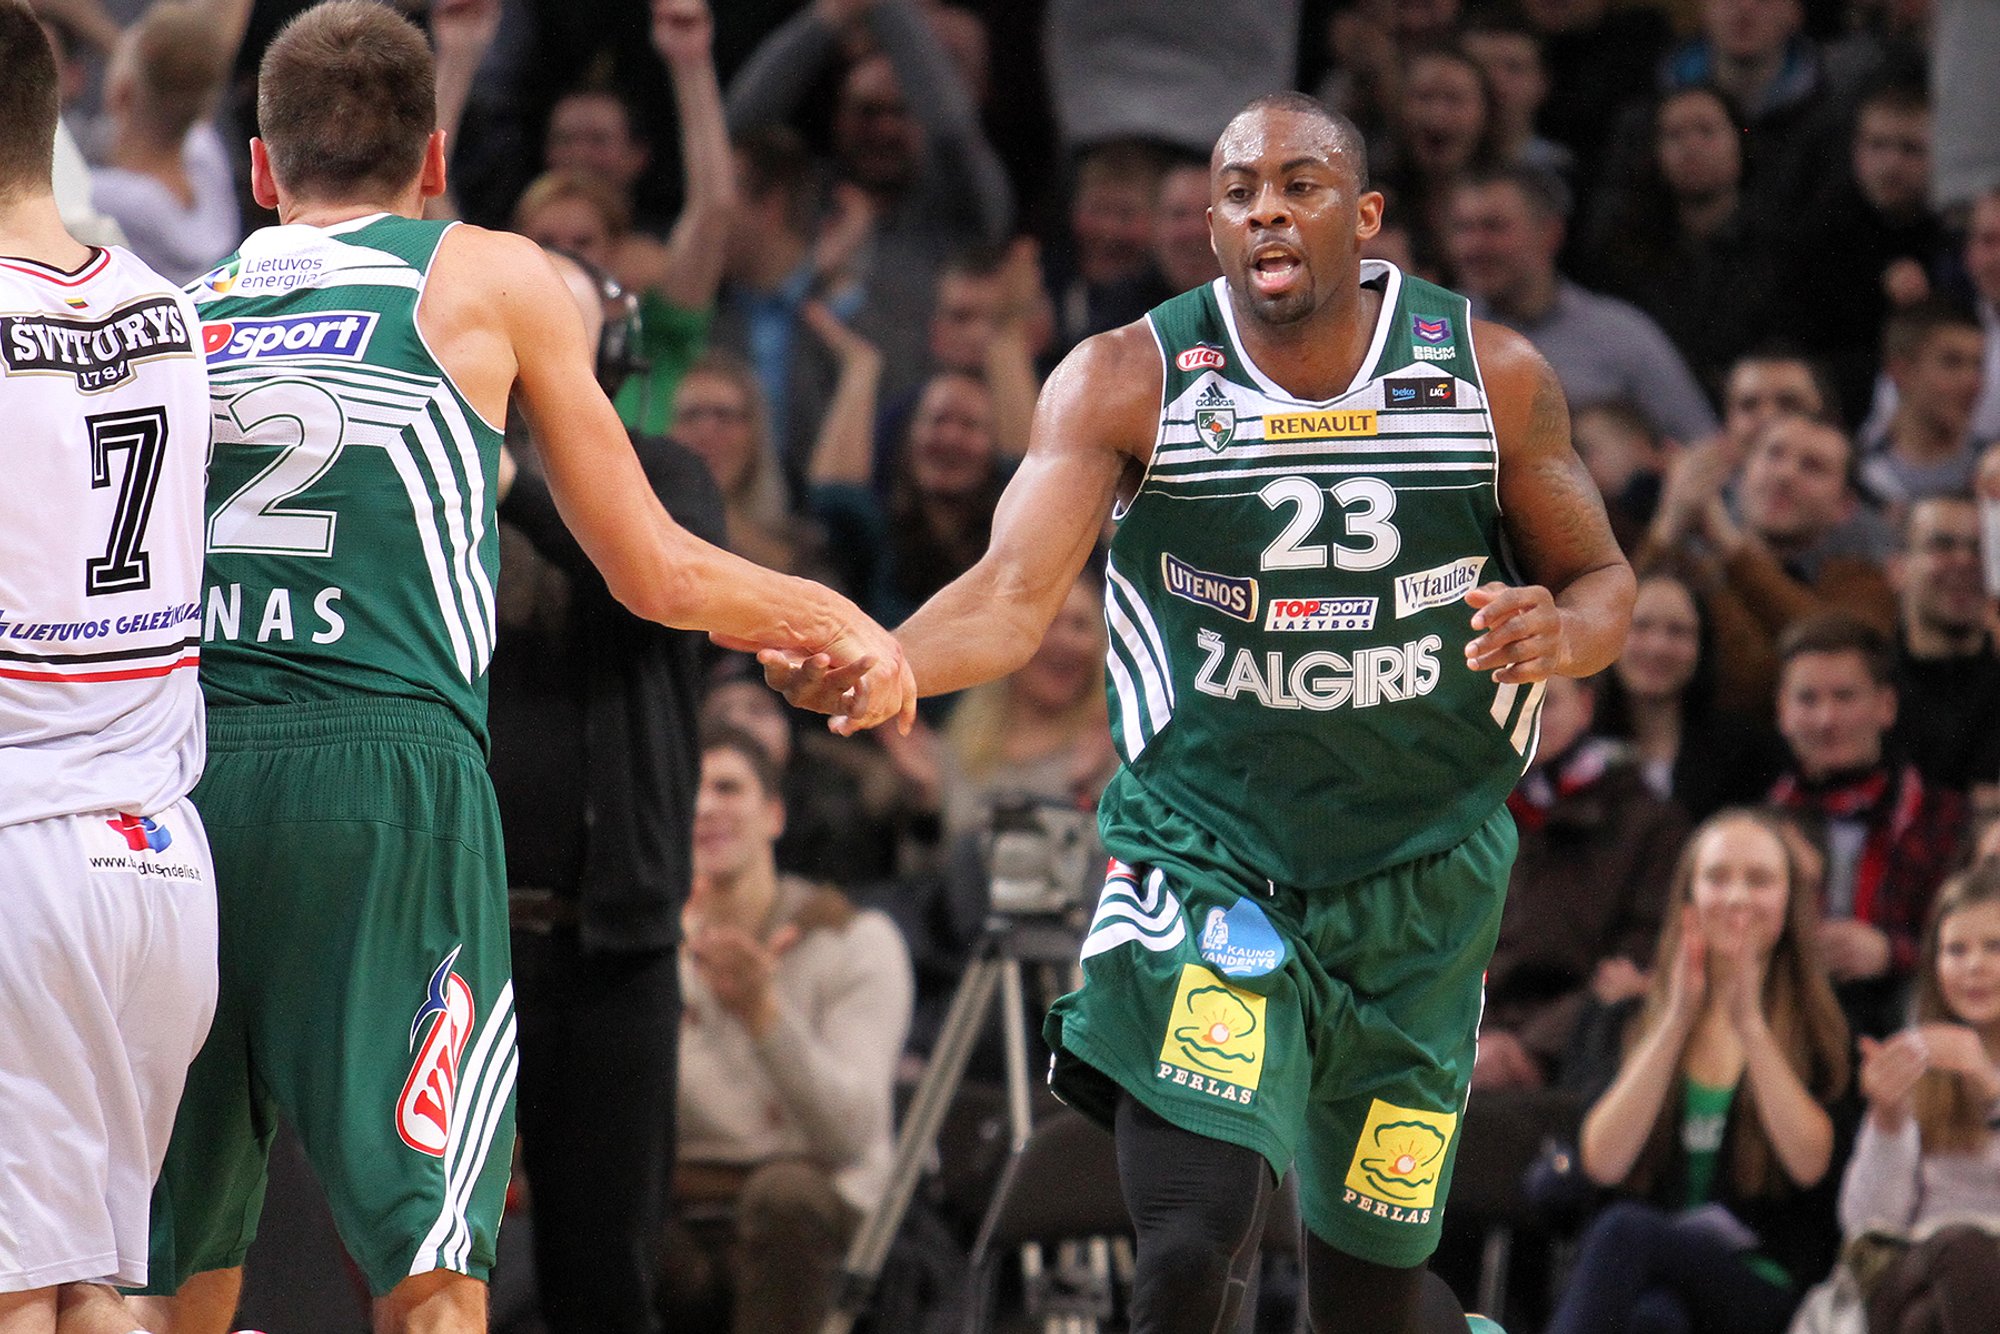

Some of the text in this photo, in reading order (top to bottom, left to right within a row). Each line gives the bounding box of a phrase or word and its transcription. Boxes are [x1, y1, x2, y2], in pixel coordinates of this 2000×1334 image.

[245, 257, 324, 274] Lietuvos
[80, 361, 125, 388] 1784
[1195, 398, 1235, 407] adidas
[1392, 387, 1416, 396] beko
[1429, 387, 1446, 397] LKL
[1270, 415, 1372, 435] RENAULT
[204, 376, 346, 558] 2
[85, 405, 169, 597] 7
[1257, 476, 1401, 572] 23
[1169, 562, 1247, 612] UTENOS
[1401, 564, 1478, 606] Vytautas
[1274, 600, 1370, 617] TOPsport
[10, 619, 110, 641] LIETUVOS
[1273, 618, 1370, 629] LAŽYBOS
[1194, 627, 1442, 711] ŽALGIRIS
[1227, 945, 1275, 958] KAUNO
[1157, 1063, 1252, 1104] PERLAS
[1343, 1189, 1431, 1224] PERLAS
